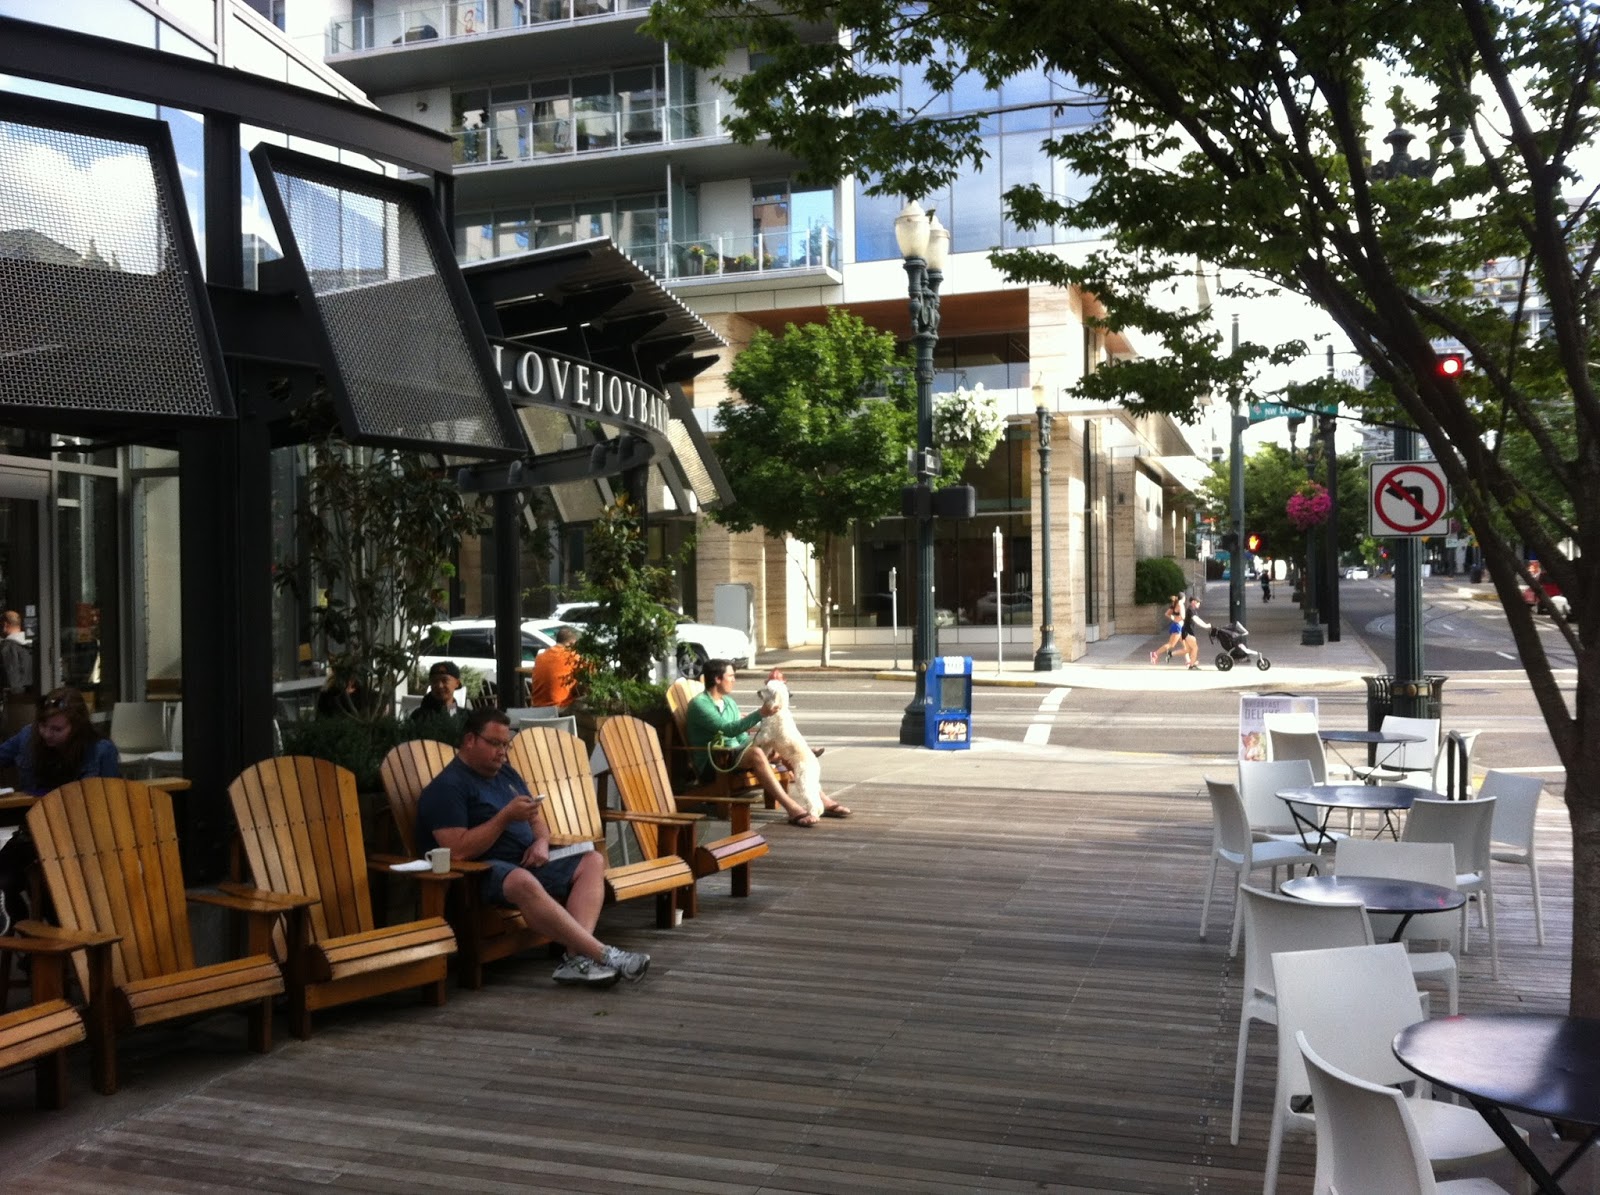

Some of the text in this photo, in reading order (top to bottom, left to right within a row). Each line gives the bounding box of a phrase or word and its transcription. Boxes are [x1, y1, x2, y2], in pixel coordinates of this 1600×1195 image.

[1341, 368, 1360, 377] ONE
[493, 344, 637, 418] LOVEJOY
[1264, 407, 1277, 415] NW
